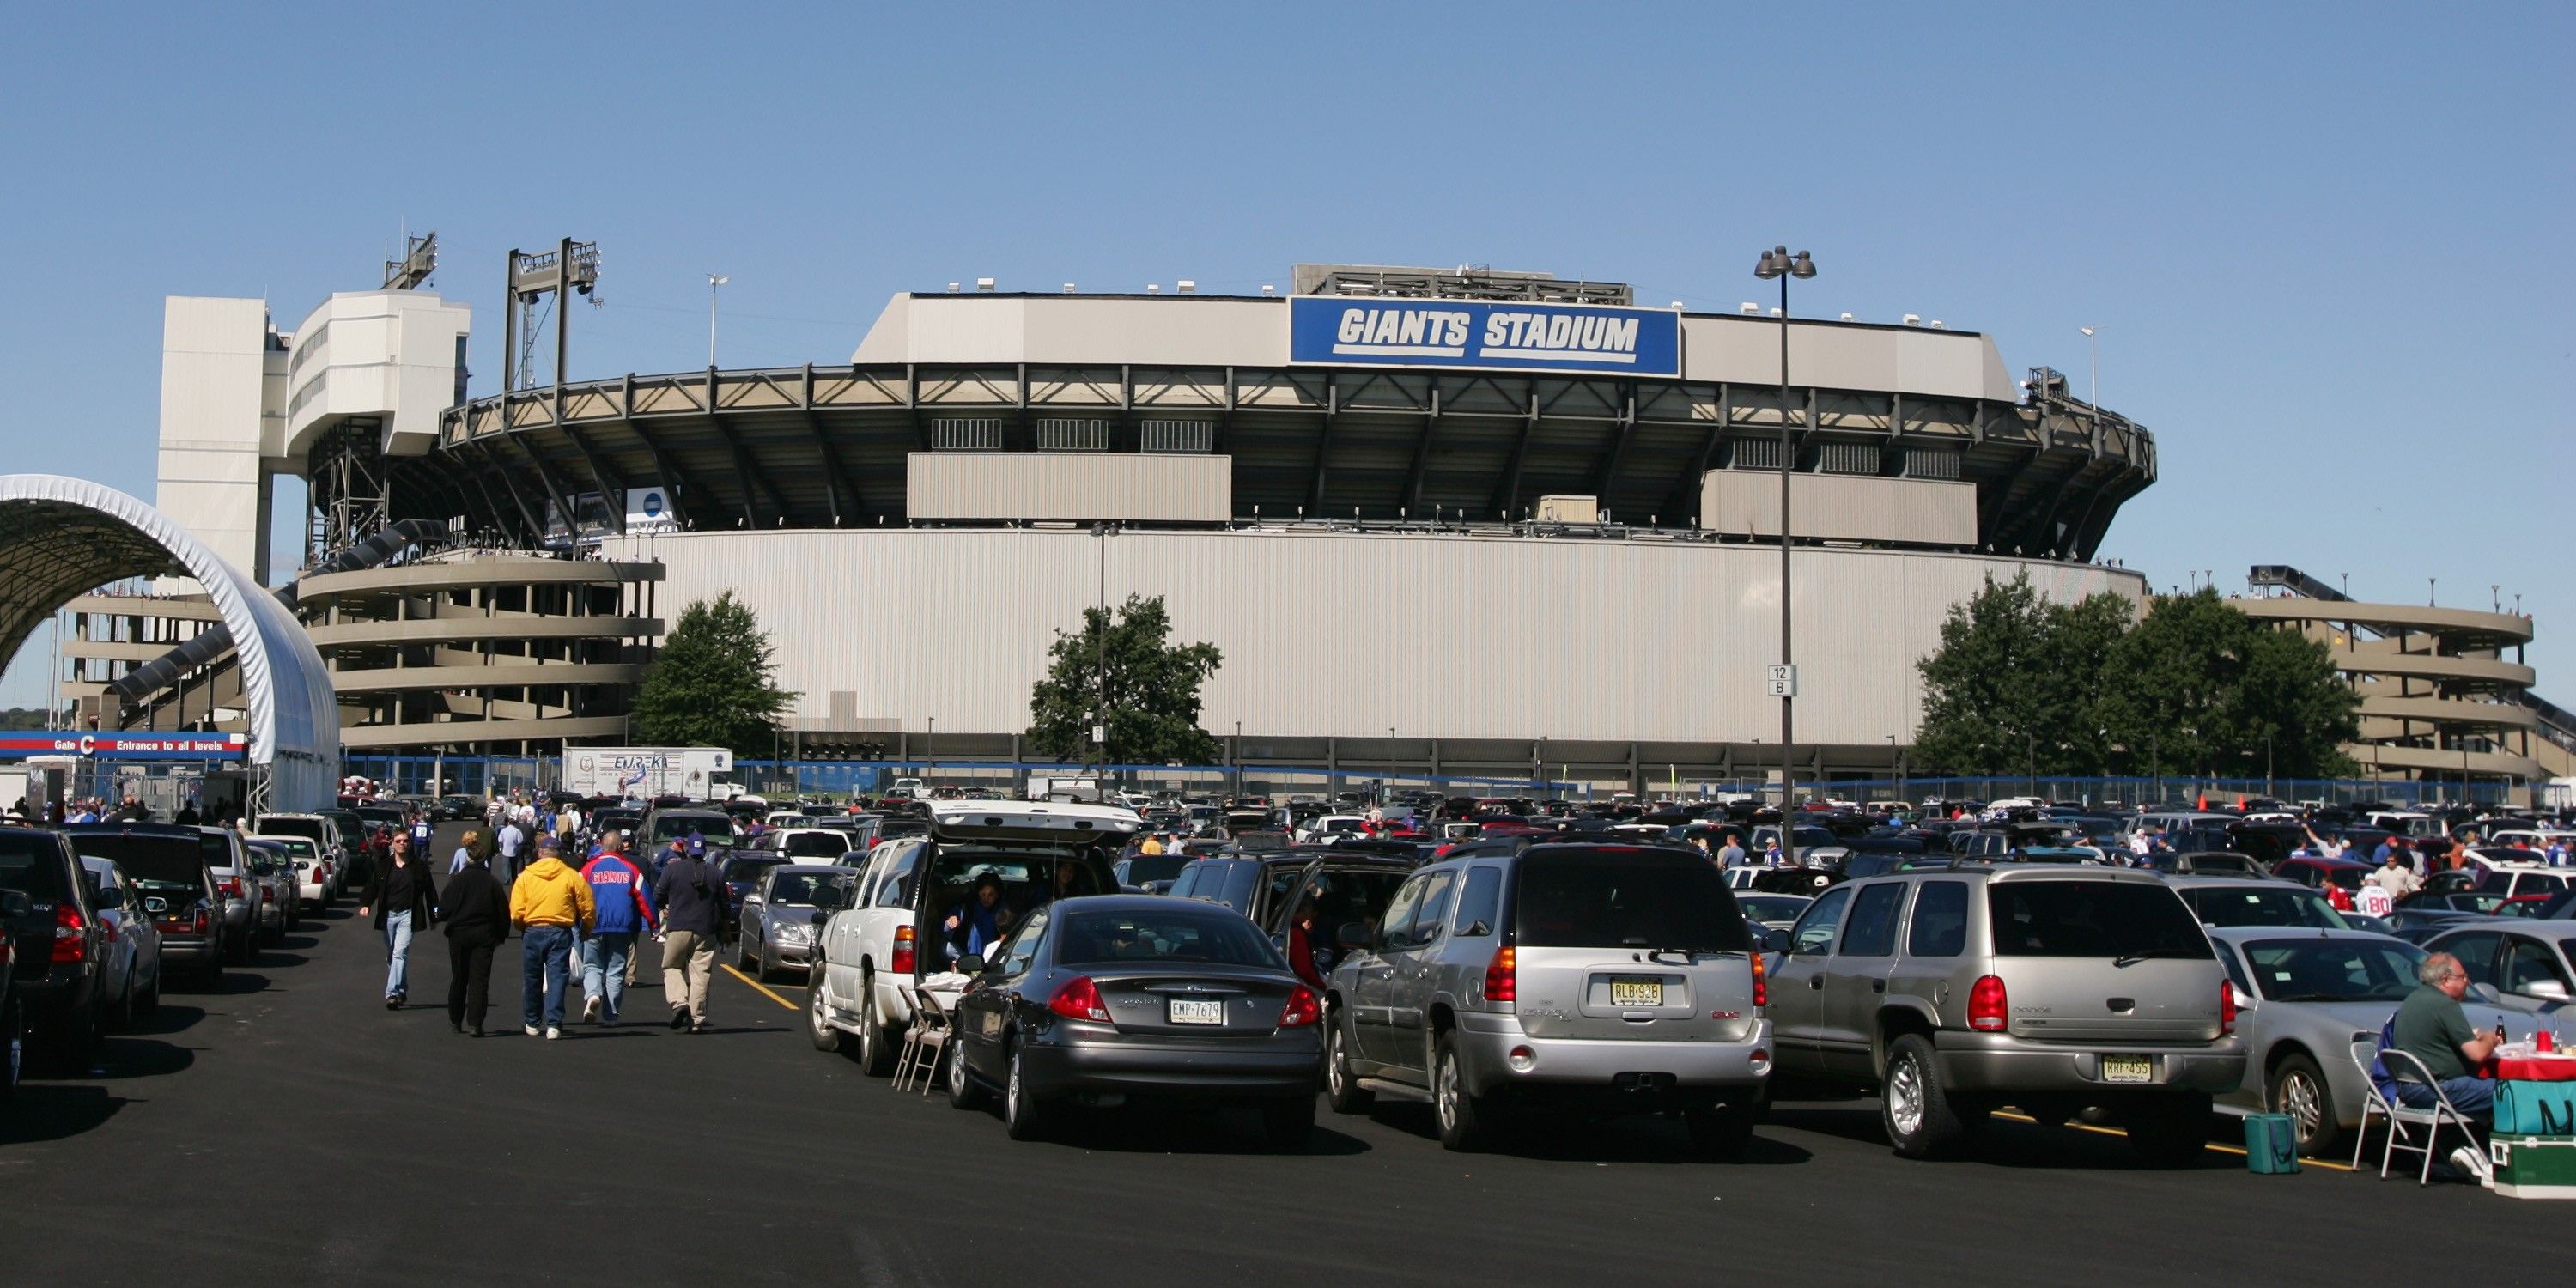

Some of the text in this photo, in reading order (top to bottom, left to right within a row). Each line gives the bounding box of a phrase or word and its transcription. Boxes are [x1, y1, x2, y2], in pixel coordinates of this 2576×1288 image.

[1338, 308, 1639, 352] GIANTS STADIUM
[1774, 667, 1786, 678] 12
[1777, 682, 1783, 693] B
[54, 735, 222, 755] Gate C Entrance to all levels
[615, 756, 668, 769] EUREKA
[592, 871, 630, 884] GIANTS
[2368, 896, 2391, 915] 80
[1710, 1010, 1740, 1018] GMC
